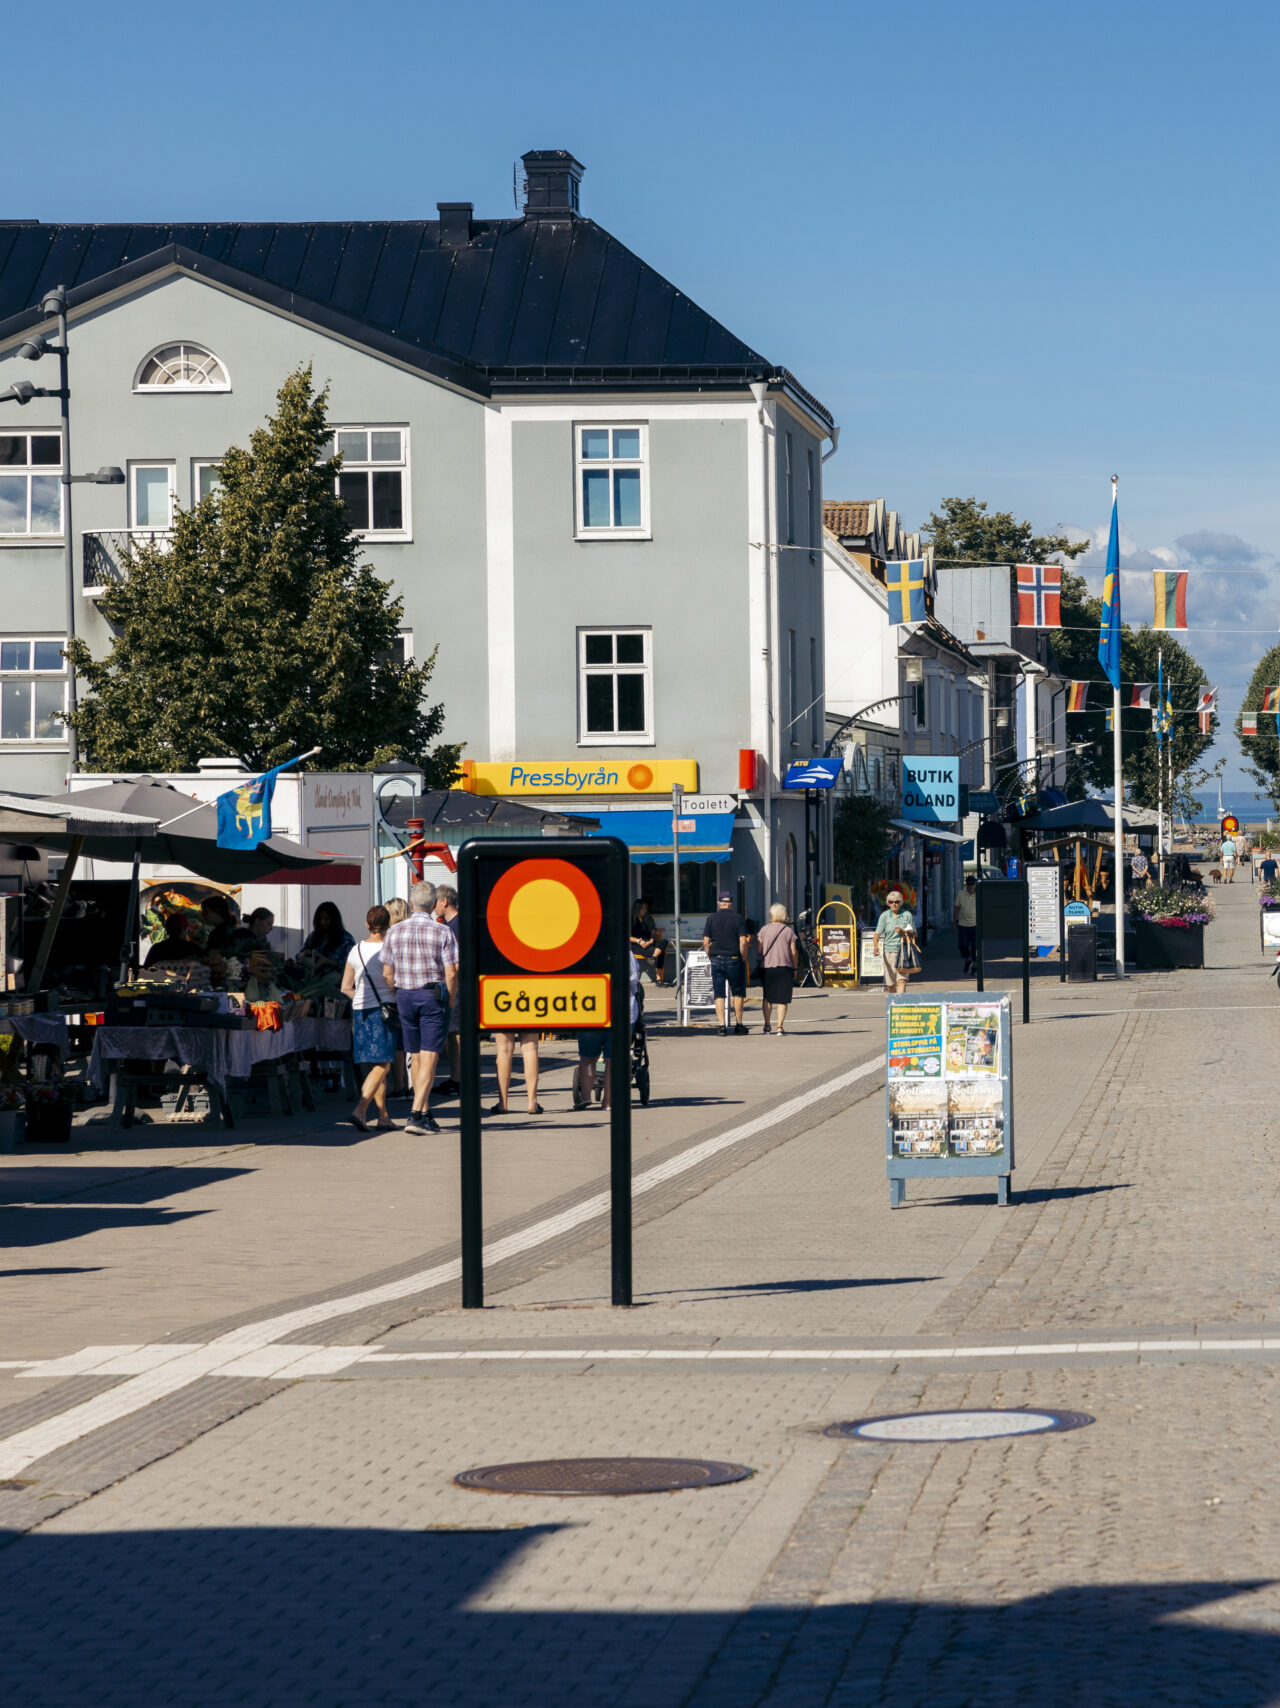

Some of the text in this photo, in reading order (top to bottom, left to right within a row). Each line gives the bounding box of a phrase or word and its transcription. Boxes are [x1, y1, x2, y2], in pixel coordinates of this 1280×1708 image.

[510, 766, 618, 790] Pressbyrån
[907, 770, 953, 783] BUTIK
[683, 800, 727, 809] Toalett
[904, 790, 955, 807] ÖLAND
[494, 990, 596, 1017] Gågata
